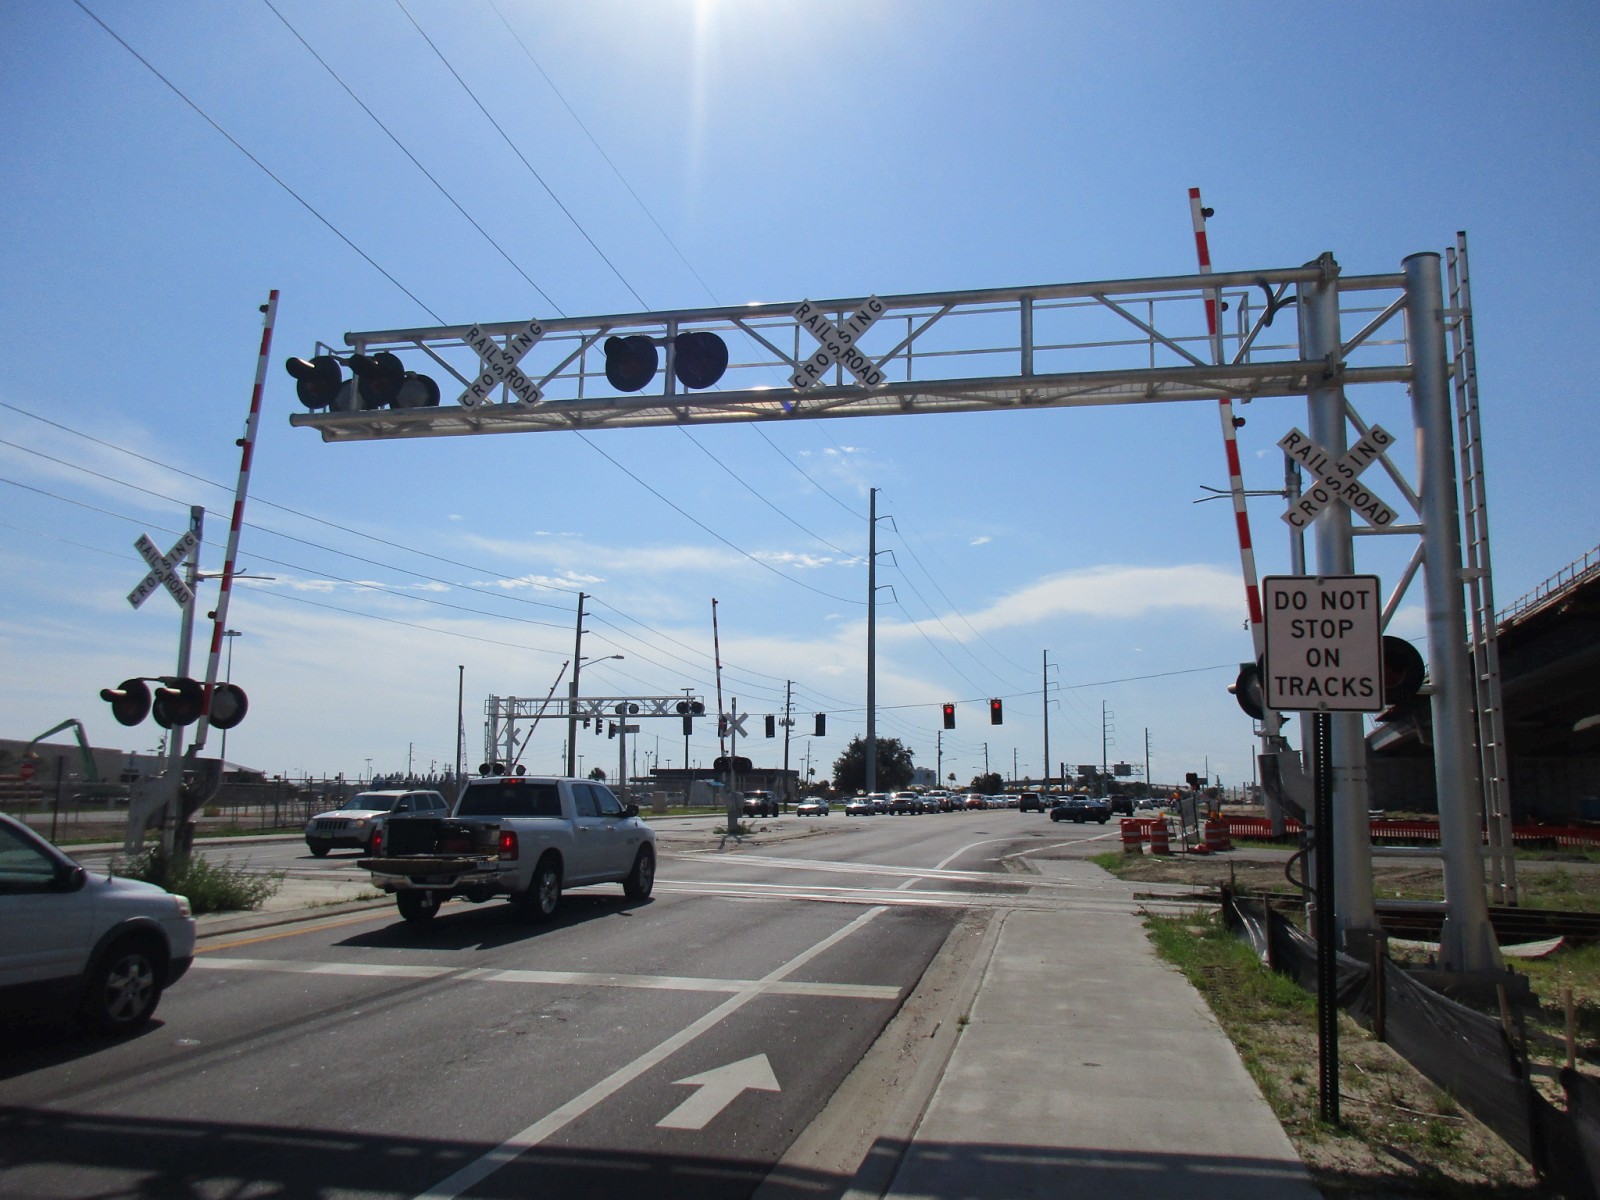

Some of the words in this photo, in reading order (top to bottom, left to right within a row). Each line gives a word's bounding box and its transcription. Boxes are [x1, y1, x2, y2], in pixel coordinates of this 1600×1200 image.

[794, 300, 882, 388] CROSSING
[462, 323, 542, 407] CROSSING
[1288, 430, 1388, 527] CROSSING
[1275, 591, 1307, 610] DO
[1321, 590, 1370, 610] NOT
[1291, 619, 1353, 639] STOP
[1306, 648, 1340, 668] ON
[1275, 676, 1373, 697] TRACKS
